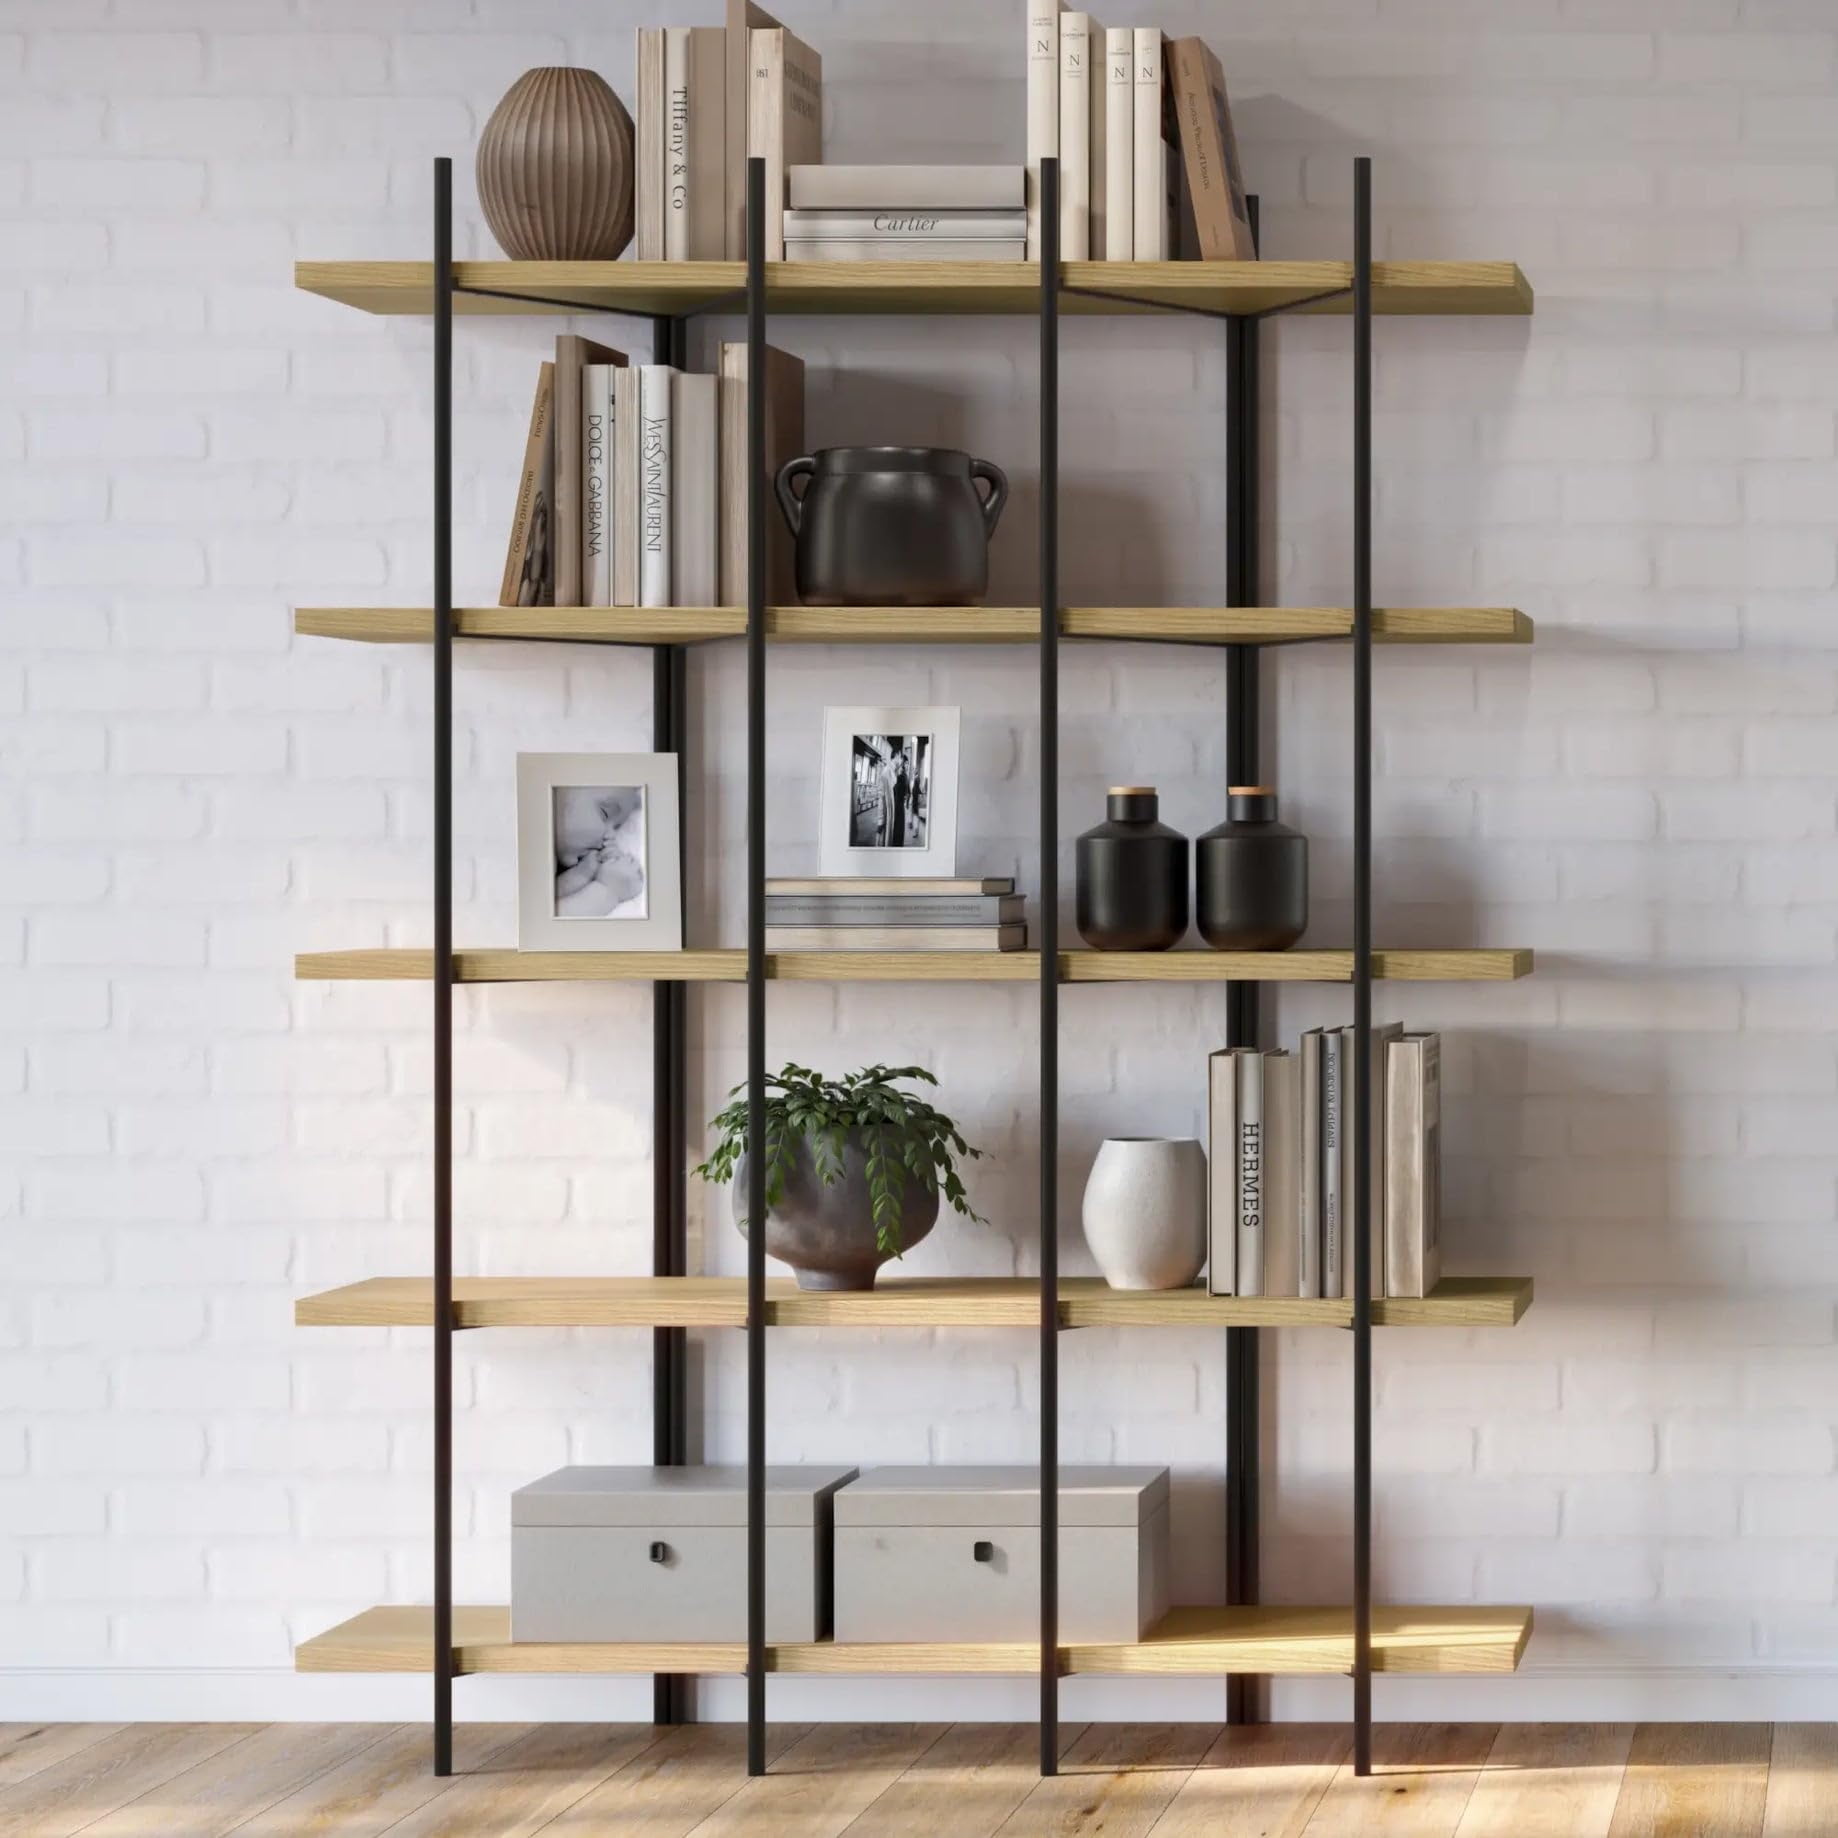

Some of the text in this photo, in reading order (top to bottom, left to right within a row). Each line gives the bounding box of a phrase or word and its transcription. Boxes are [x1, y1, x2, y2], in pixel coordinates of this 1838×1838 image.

[1037, 40, 1049, 52] N
[1070, 54, 1081, 66] N
[1115, 67, 1125, 78] N
[1142, 67, 1153, 78] N
[669, 86, 688, 210] Tiffany & Co
[873, 213, 940, 231] Cartier
[588, 414, 603, 465] DOLCE
[587, 476, 603, 557] GABBANA
[1242, 1122, 1259, 1226] HERMES
